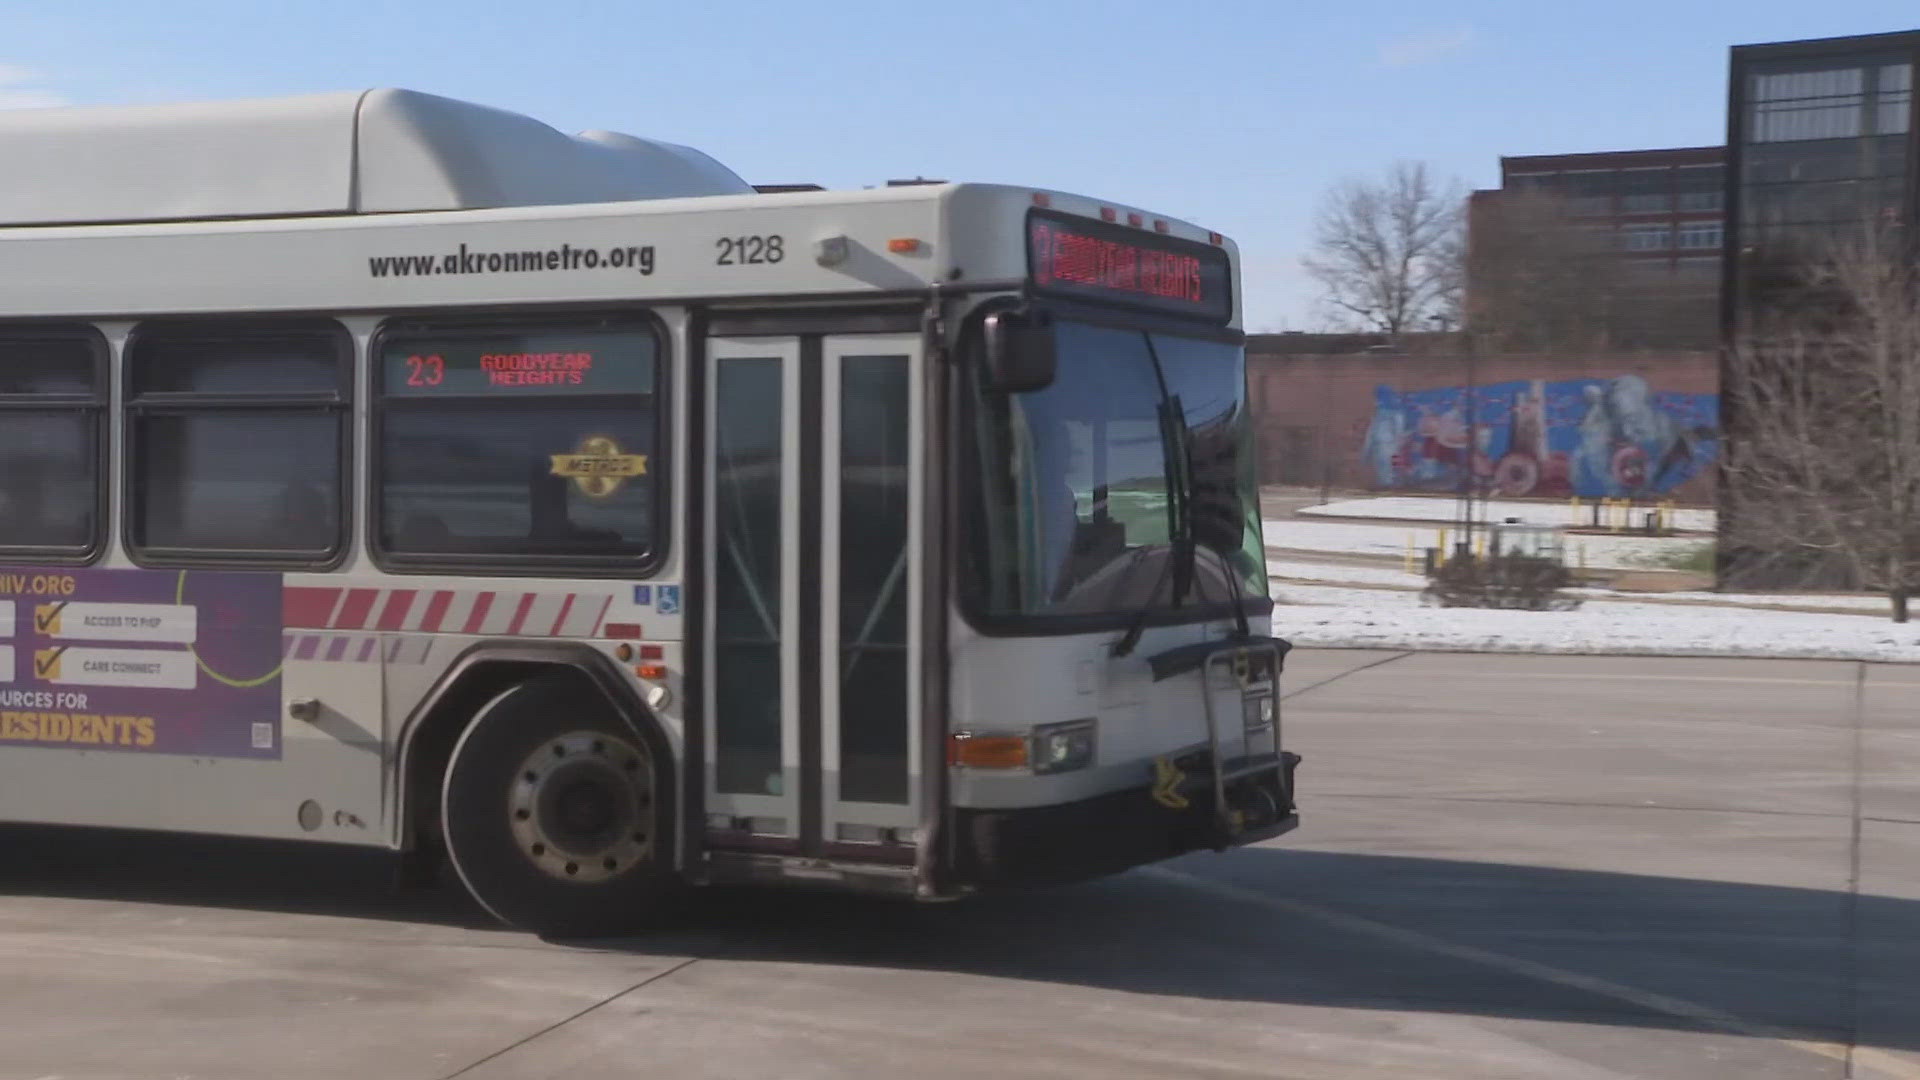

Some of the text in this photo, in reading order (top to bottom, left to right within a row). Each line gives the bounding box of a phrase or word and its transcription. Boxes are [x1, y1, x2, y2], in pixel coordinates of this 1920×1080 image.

[369, 243, 656, 277] www.akronmetro.org
[715, 235, 785, 266] 2128
[406, 355, 445, 386] 23
[480, 353, 592, 370] GOODYEAR
[489, 370, 583, 385] HEIGHTS
[83, 660, 109, 672] CARE
[0, 689, 88, 709] URCES FOR
